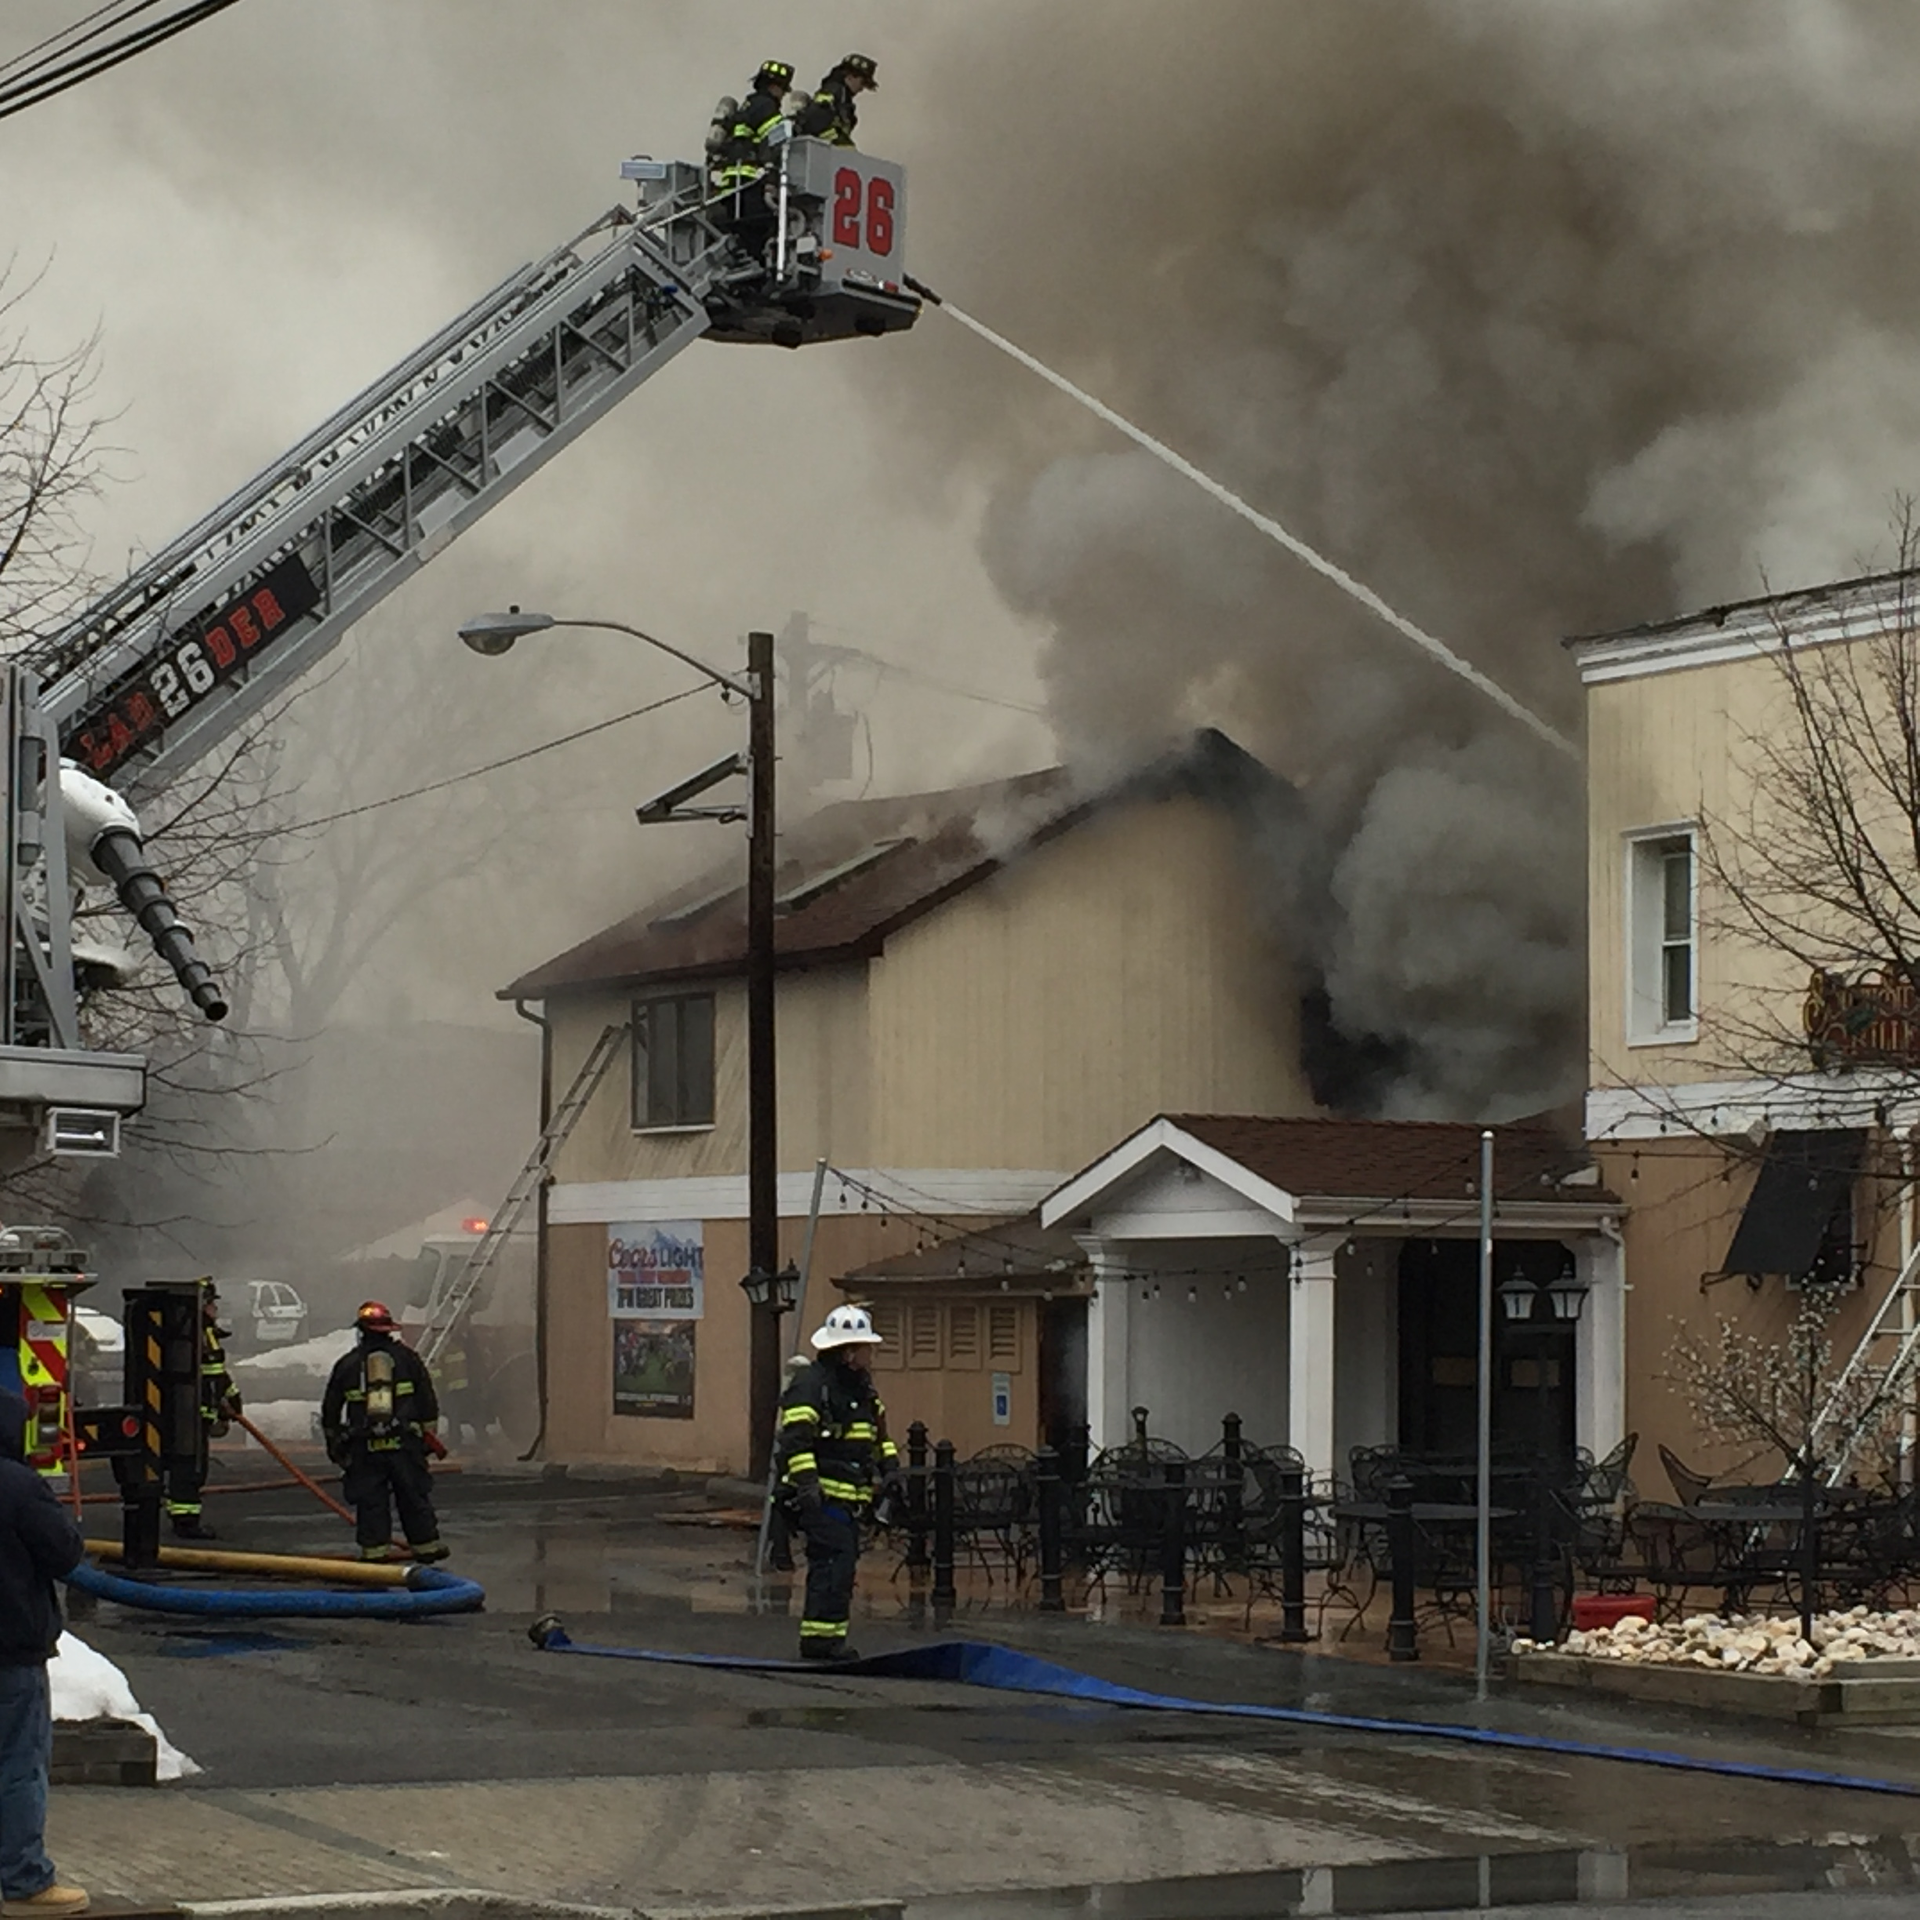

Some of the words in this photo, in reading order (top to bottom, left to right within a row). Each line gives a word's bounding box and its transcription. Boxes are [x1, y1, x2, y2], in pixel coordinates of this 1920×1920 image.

[833, 166, 895, 257] 26
[149, 641, 215, 718] 26
[204, 588, 286, 669] DER
[660, 1245, 705, 1270] LIGHT
